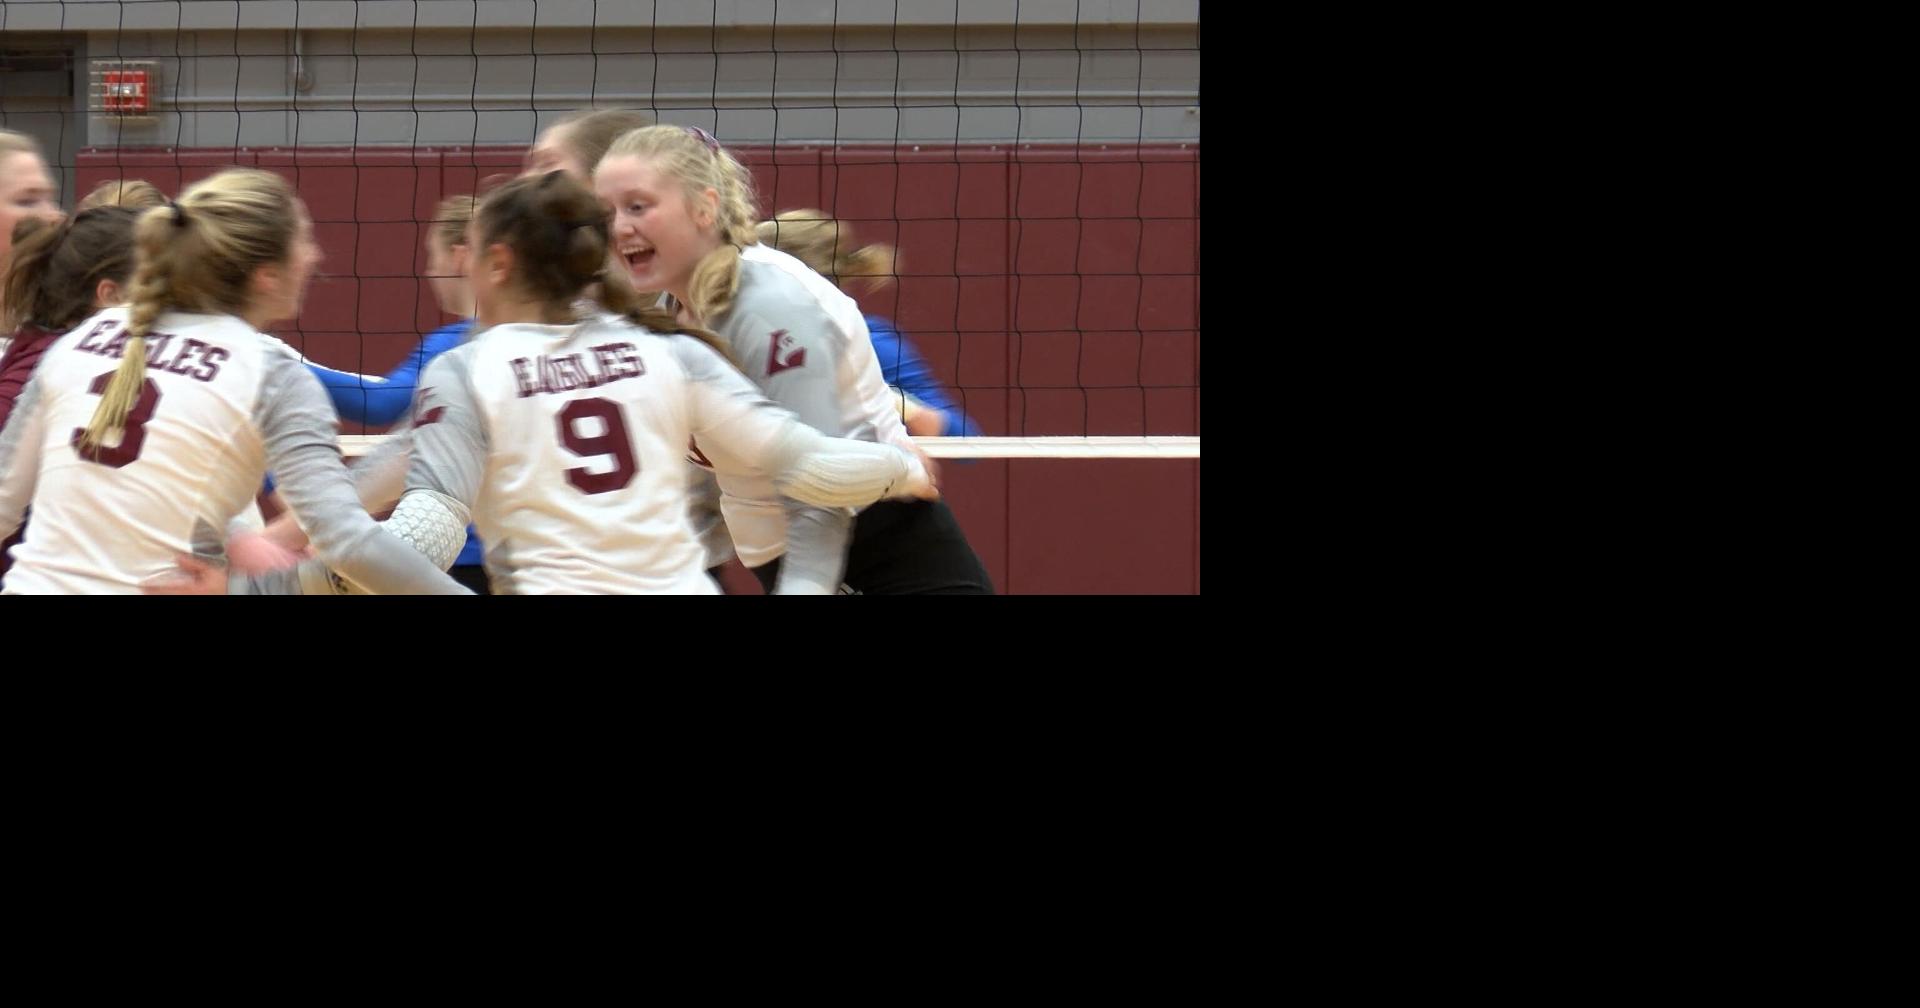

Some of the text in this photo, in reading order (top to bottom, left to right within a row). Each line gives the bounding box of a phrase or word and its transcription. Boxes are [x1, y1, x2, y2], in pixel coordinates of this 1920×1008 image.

[73, 319, 231, 382] EALES
[509, 342, 646, 398] EAGLES
[69, 369, 163, 469] 3
[554, 397, 641, 496] 9
